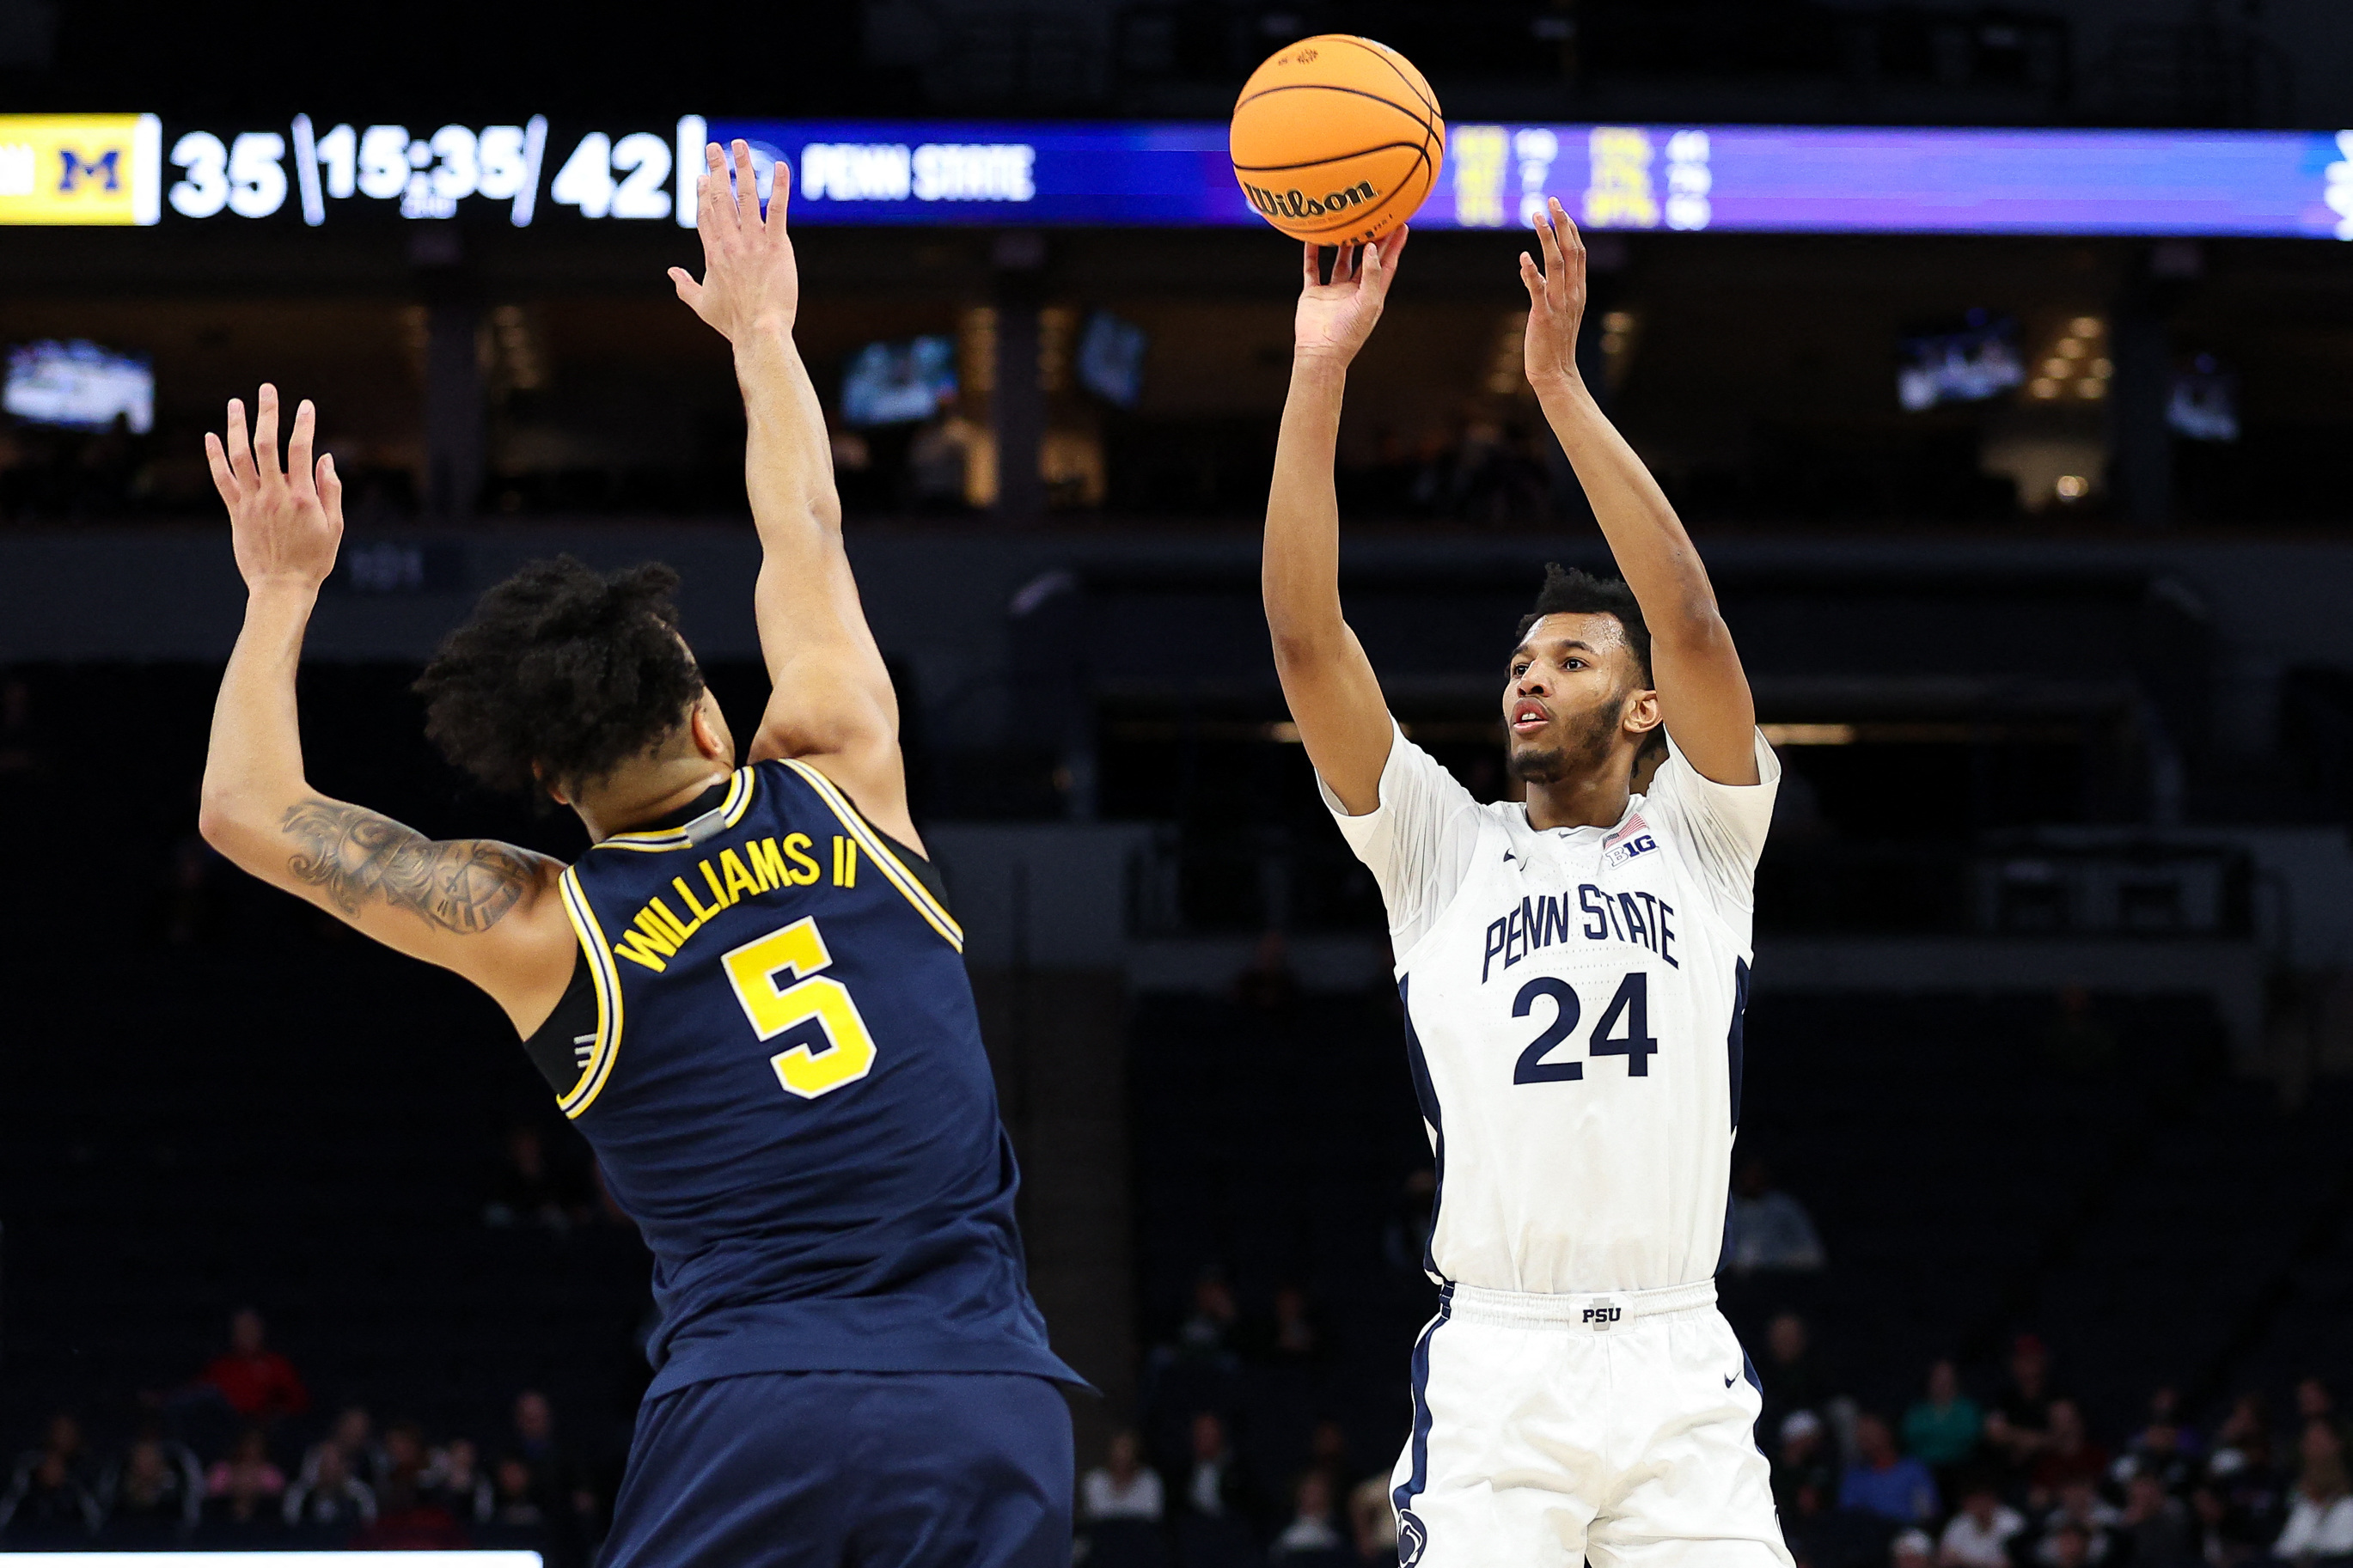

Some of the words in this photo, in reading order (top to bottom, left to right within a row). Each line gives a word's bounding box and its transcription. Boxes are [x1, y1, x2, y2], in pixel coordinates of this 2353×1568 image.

[169, 131, 286, 218] 35
[316, 123, 528, 199] 15:35
[552, 132, 672, 218] 42
[912, 143, 1036, 201] STATE
[1243, 180, 1377, 218] Wilson
[614, 833, 821, 973] WILLIAMS
[1482, 891, 1568, 985] PENN
[1578, 884, 1679, 970] STATE
[720, 915, 877, 1099] 5
[1512, 972, 1658, 1085] 24
[1582, 1308, 1622, 1323] PSU
